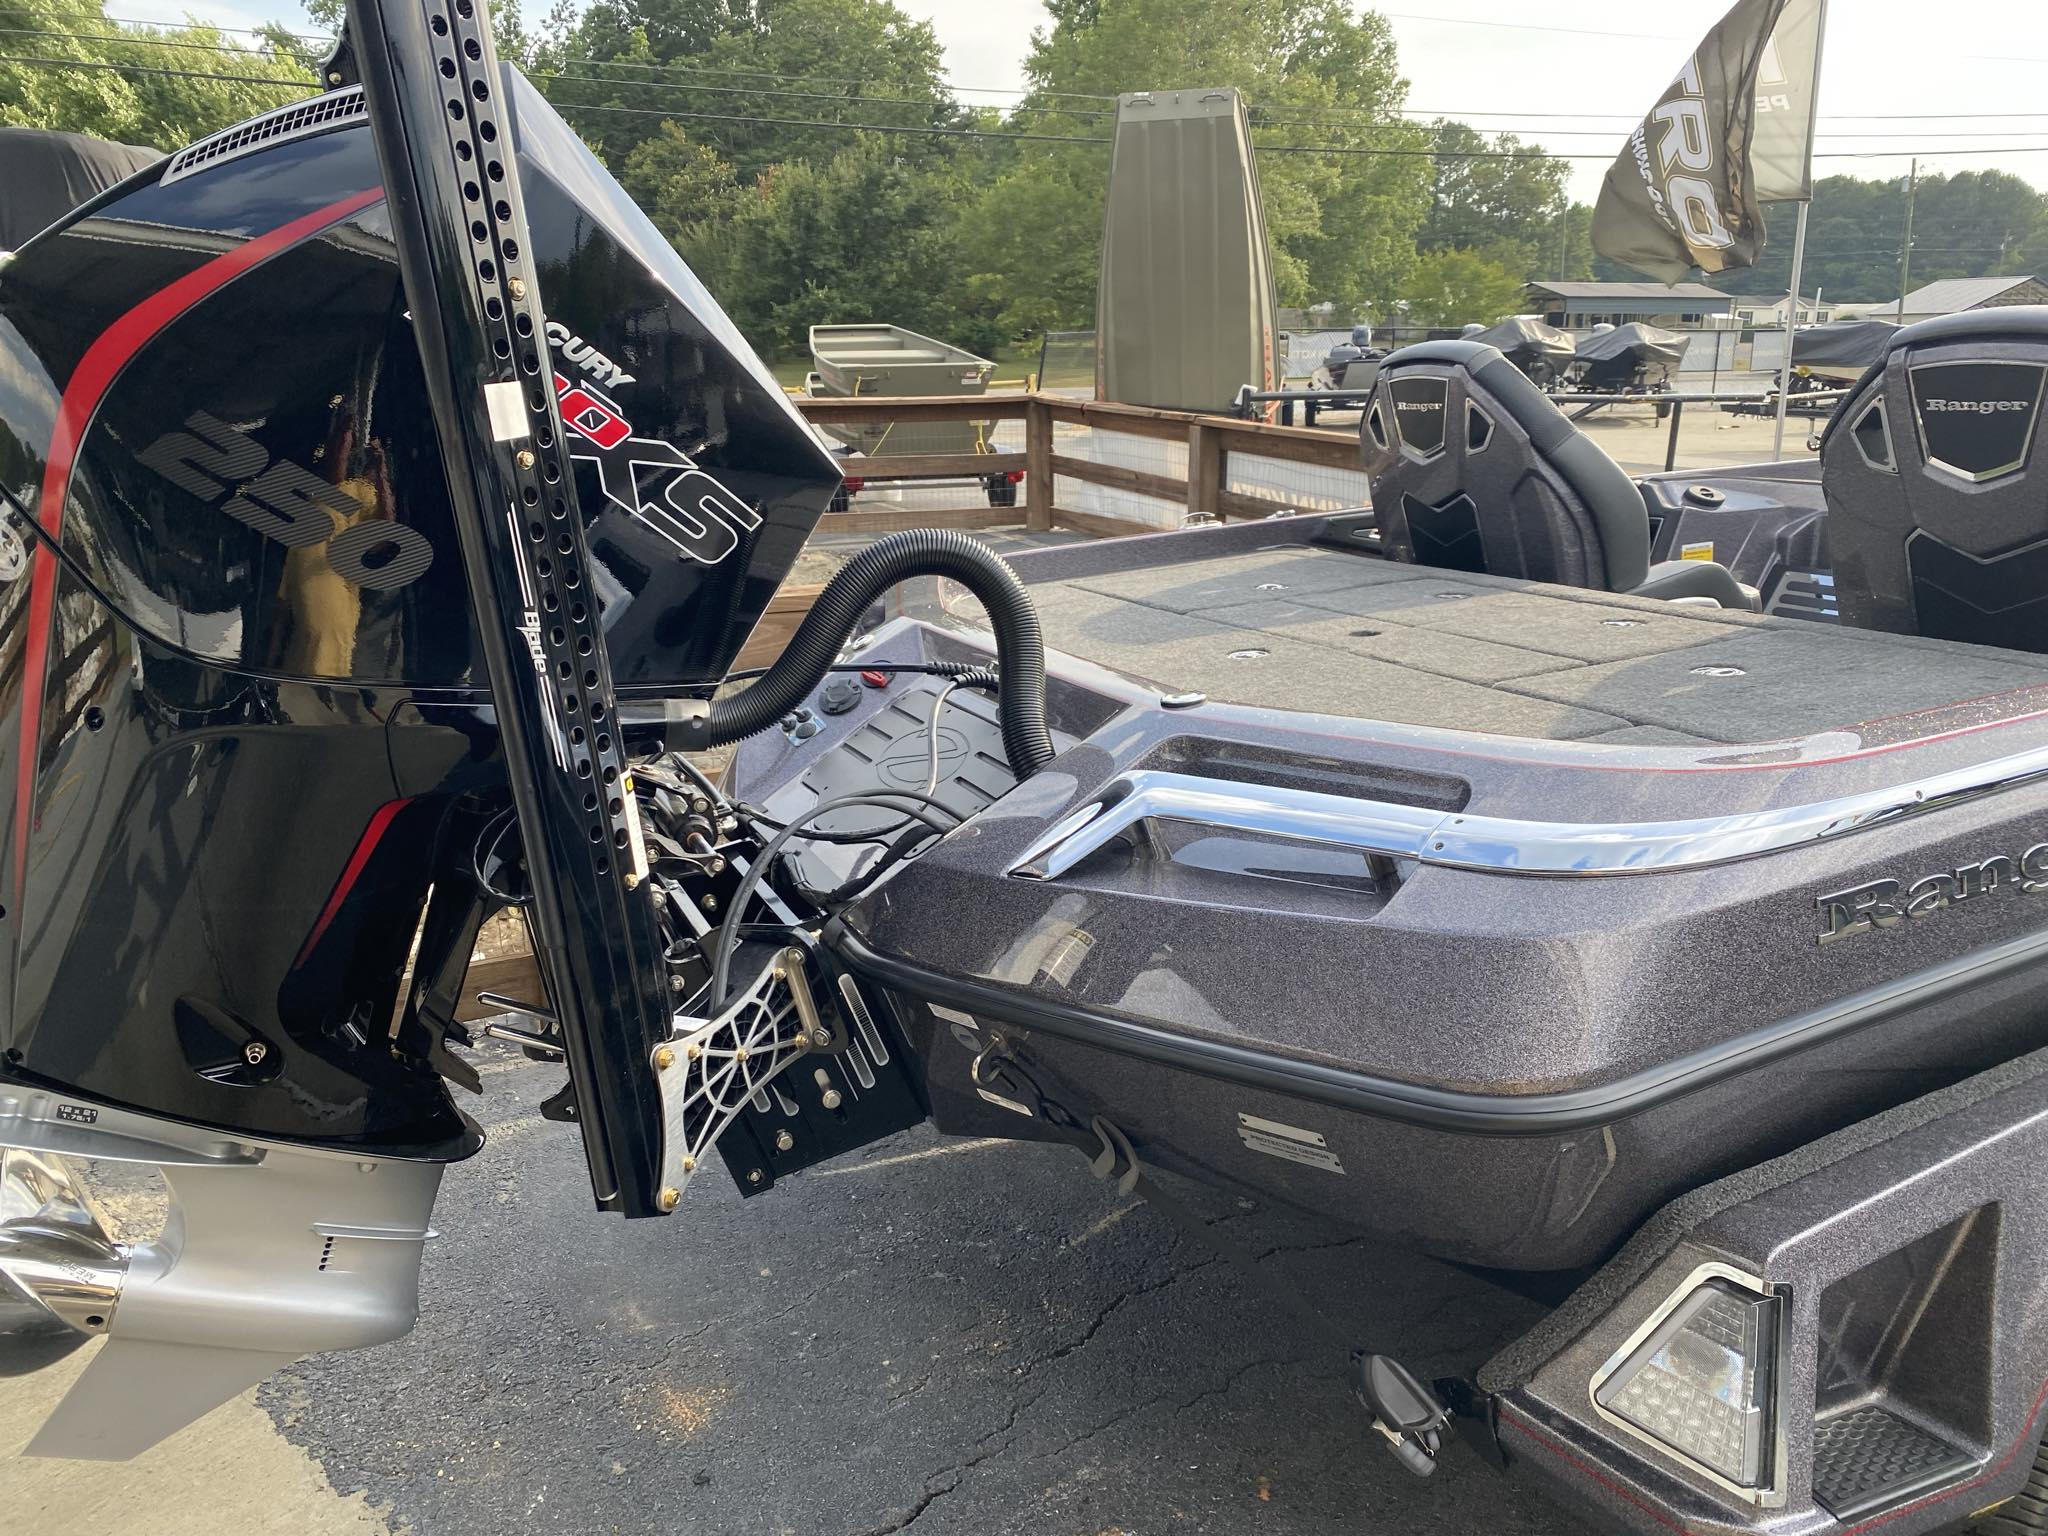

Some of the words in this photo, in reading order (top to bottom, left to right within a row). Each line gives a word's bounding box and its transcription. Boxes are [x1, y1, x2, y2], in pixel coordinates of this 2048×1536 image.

[546, 317, 637, 391] CURY
[1397, 401, 1443, 412] Ranger
[1926, 399, 2029, 414] Ranger
[134, 410, 434, 592] 250
[516, 611, 547, 673] Blade
